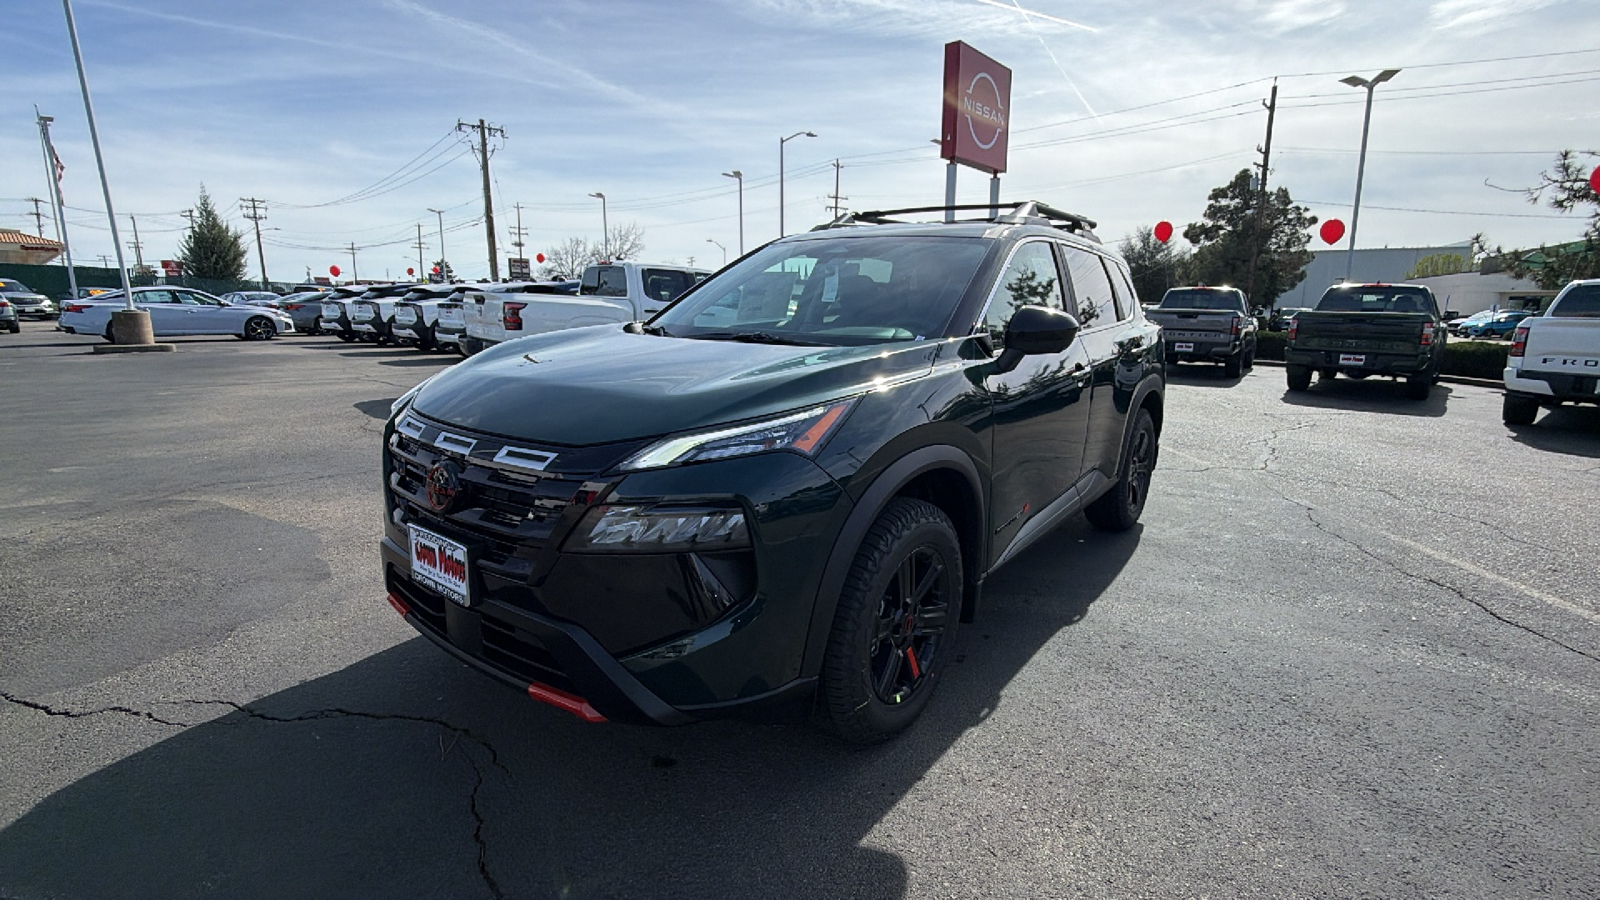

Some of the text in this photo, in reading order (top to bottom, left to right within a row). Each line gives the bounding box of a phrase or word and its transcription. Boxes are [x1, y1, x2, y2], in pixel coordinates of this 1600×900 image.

[964, 96, 1004, 126] NISSAN
[414, 572, 436, 591] CROWN
[436, 583, 464, 604] MOTORS
